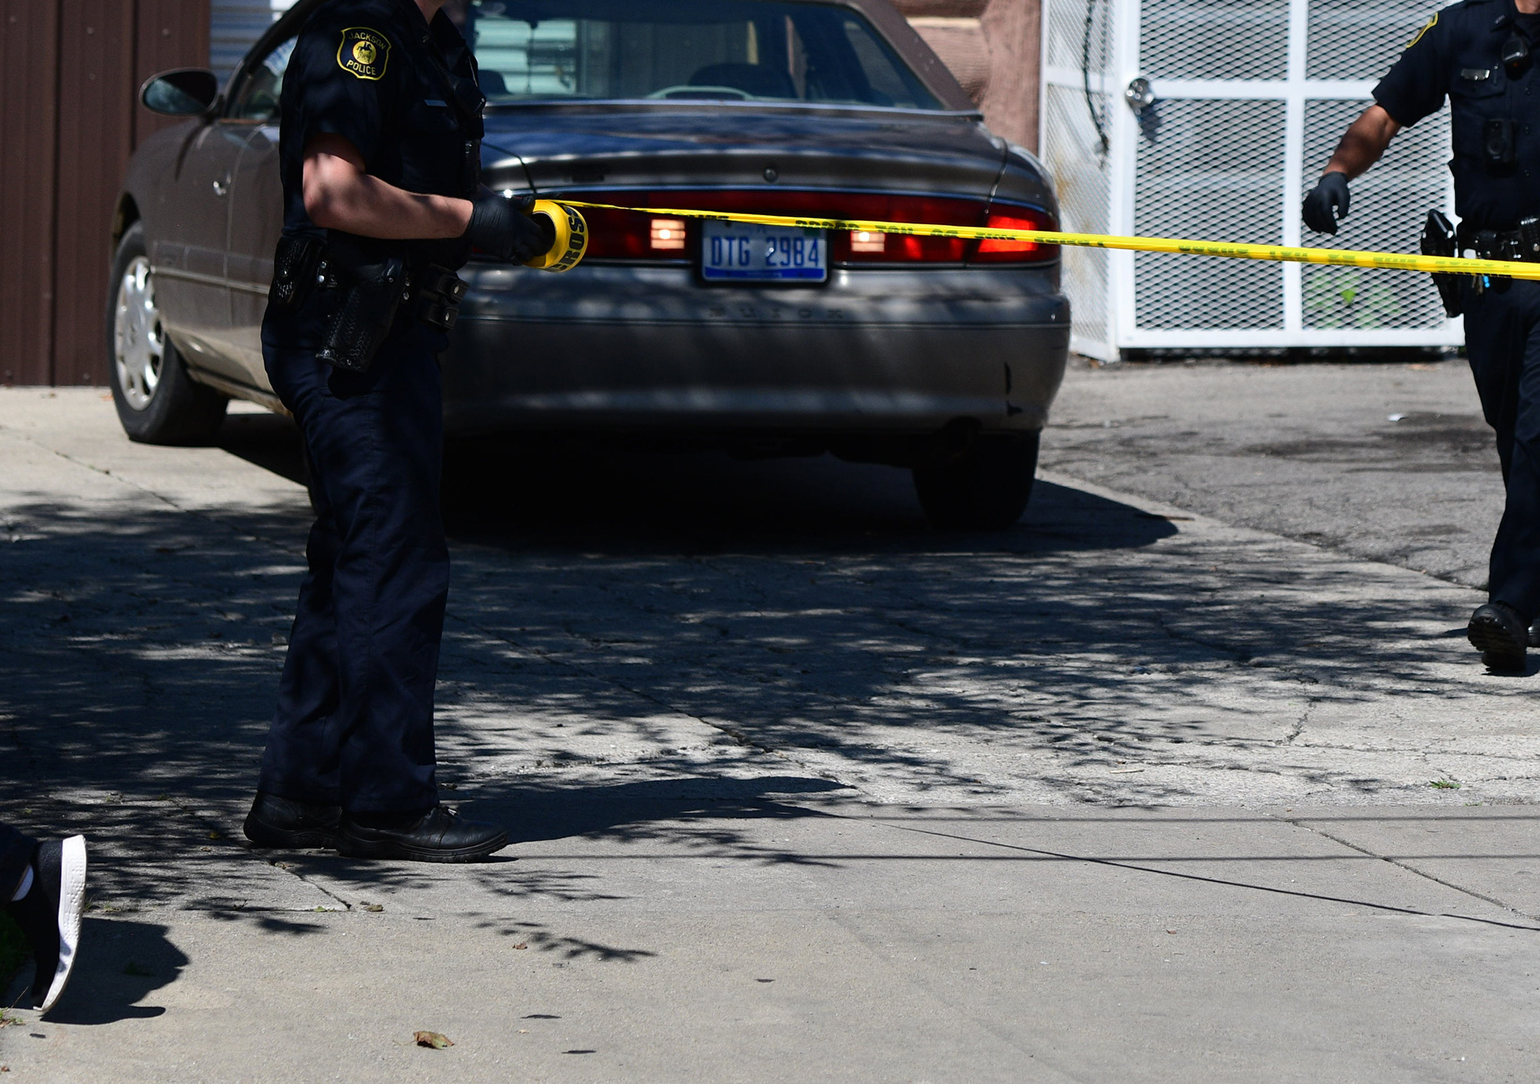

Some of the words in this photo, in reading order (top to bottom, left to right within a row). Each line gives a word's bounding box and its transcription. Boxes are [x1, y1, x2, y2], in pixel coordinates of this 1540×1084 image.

[348, 32, 387, 50] JACKSON
[346, 59, 377, 76] POLICE
[765, 236, 820, 267] 2984
